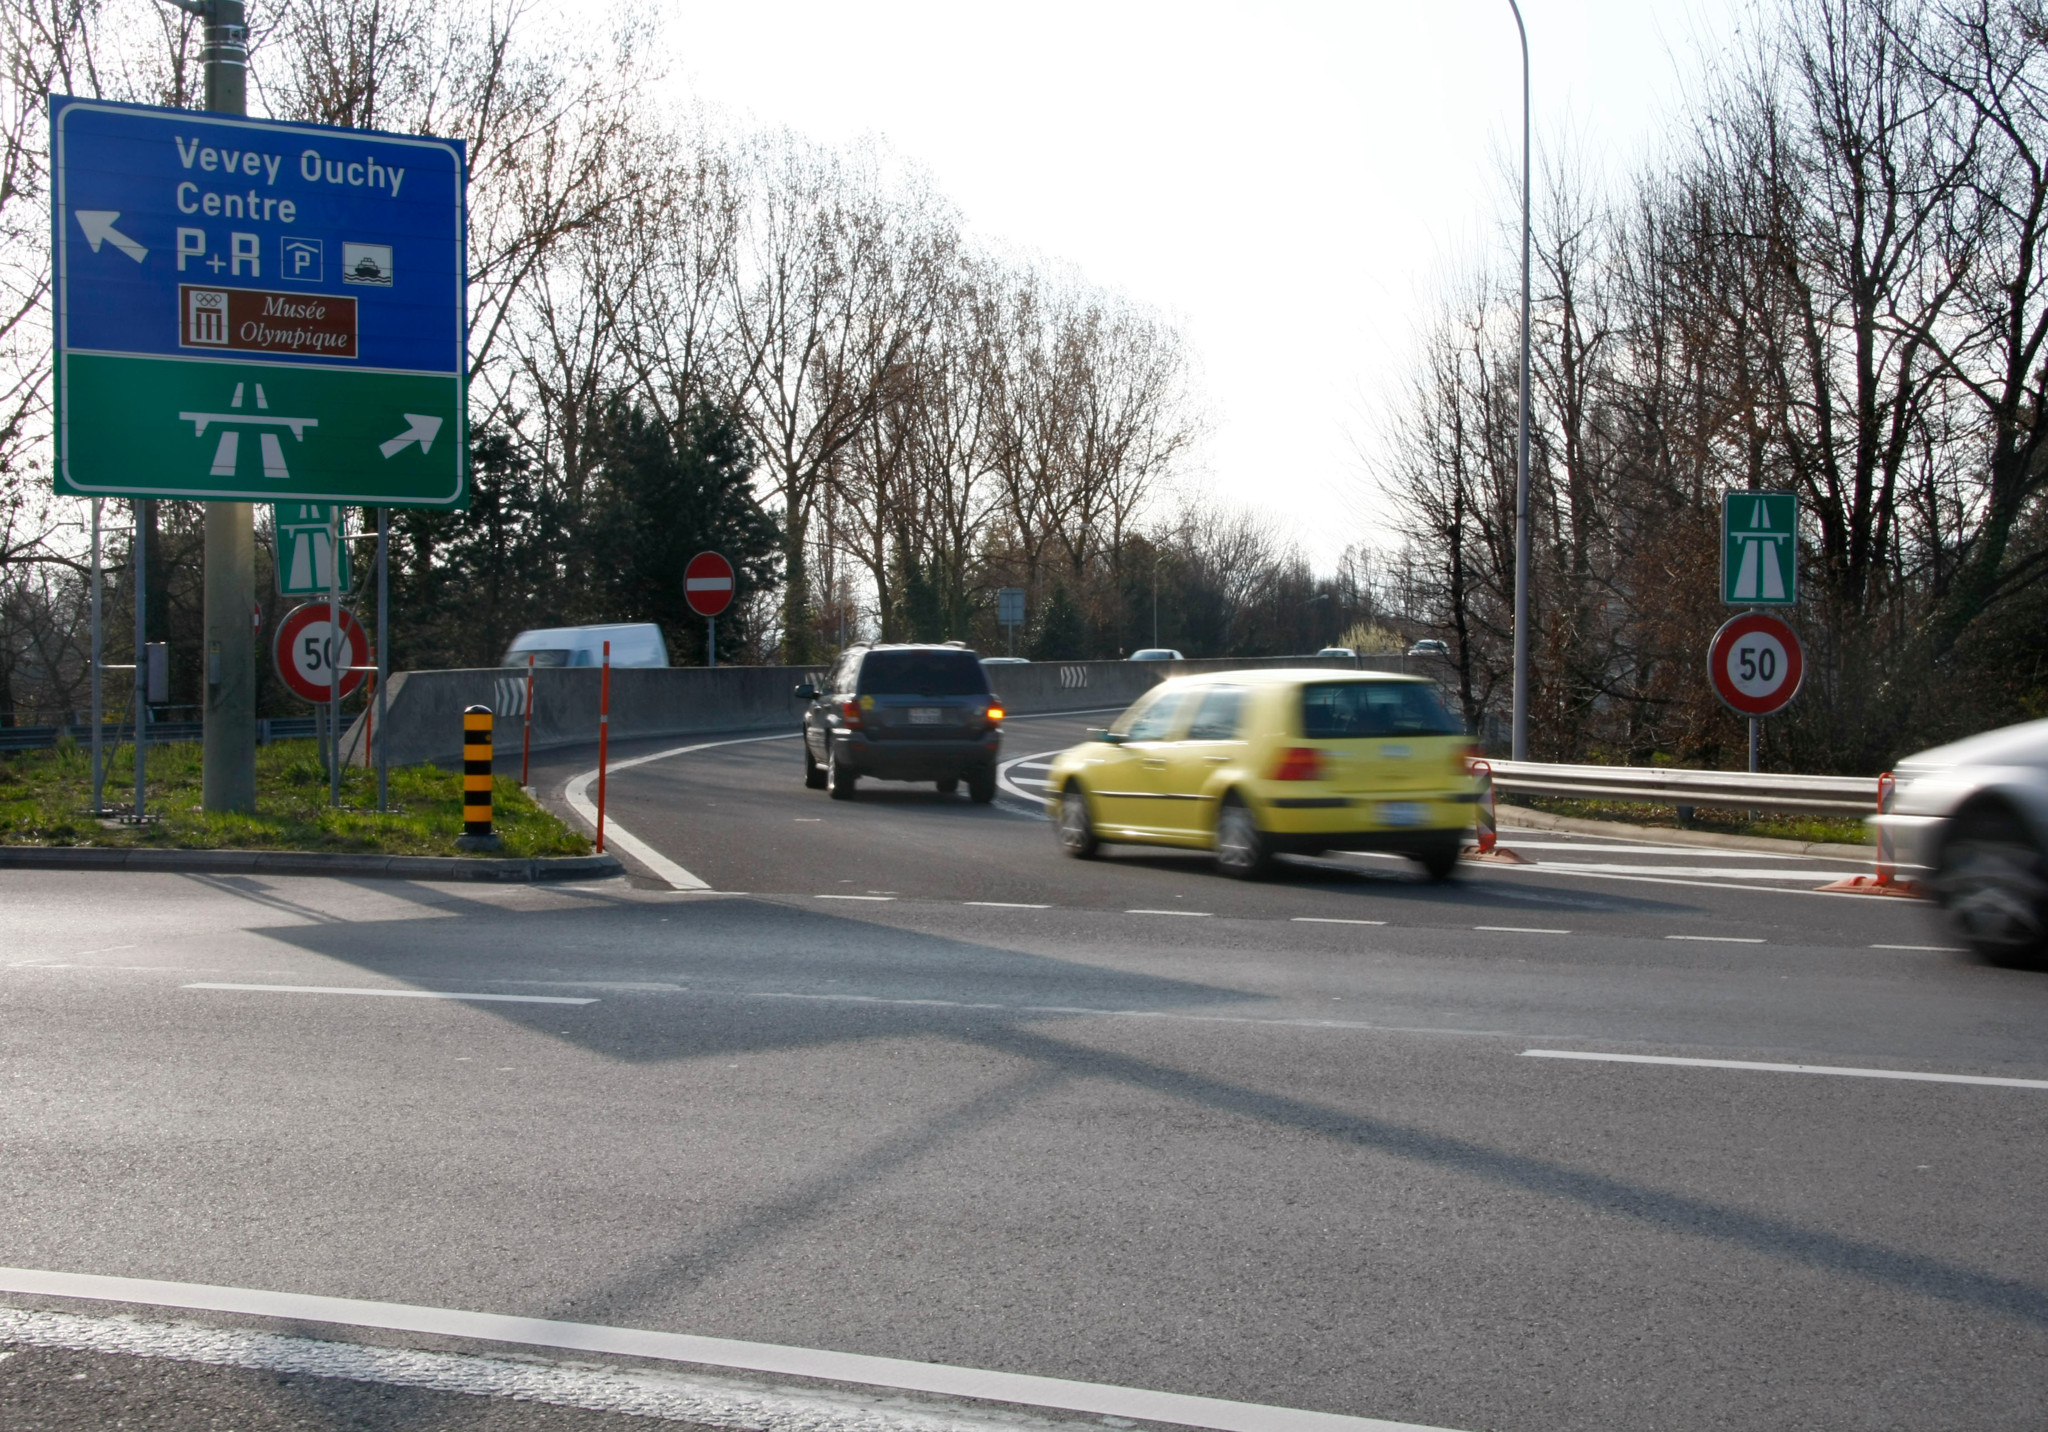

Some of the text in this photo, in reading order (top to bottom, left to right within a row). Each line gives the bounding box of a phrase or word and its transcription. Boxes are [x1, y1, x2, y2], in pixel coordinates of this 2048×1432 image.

[175, 136, 405, 197] Vevey Ouchy
[177, 182, 296, 223] Centre
[177, 227, 310, 277] P+R P
[262, 296, 326, 320] Musée
[240, 321, 347, 350] Olympique
[1740, 648, 1776, 681] 50
